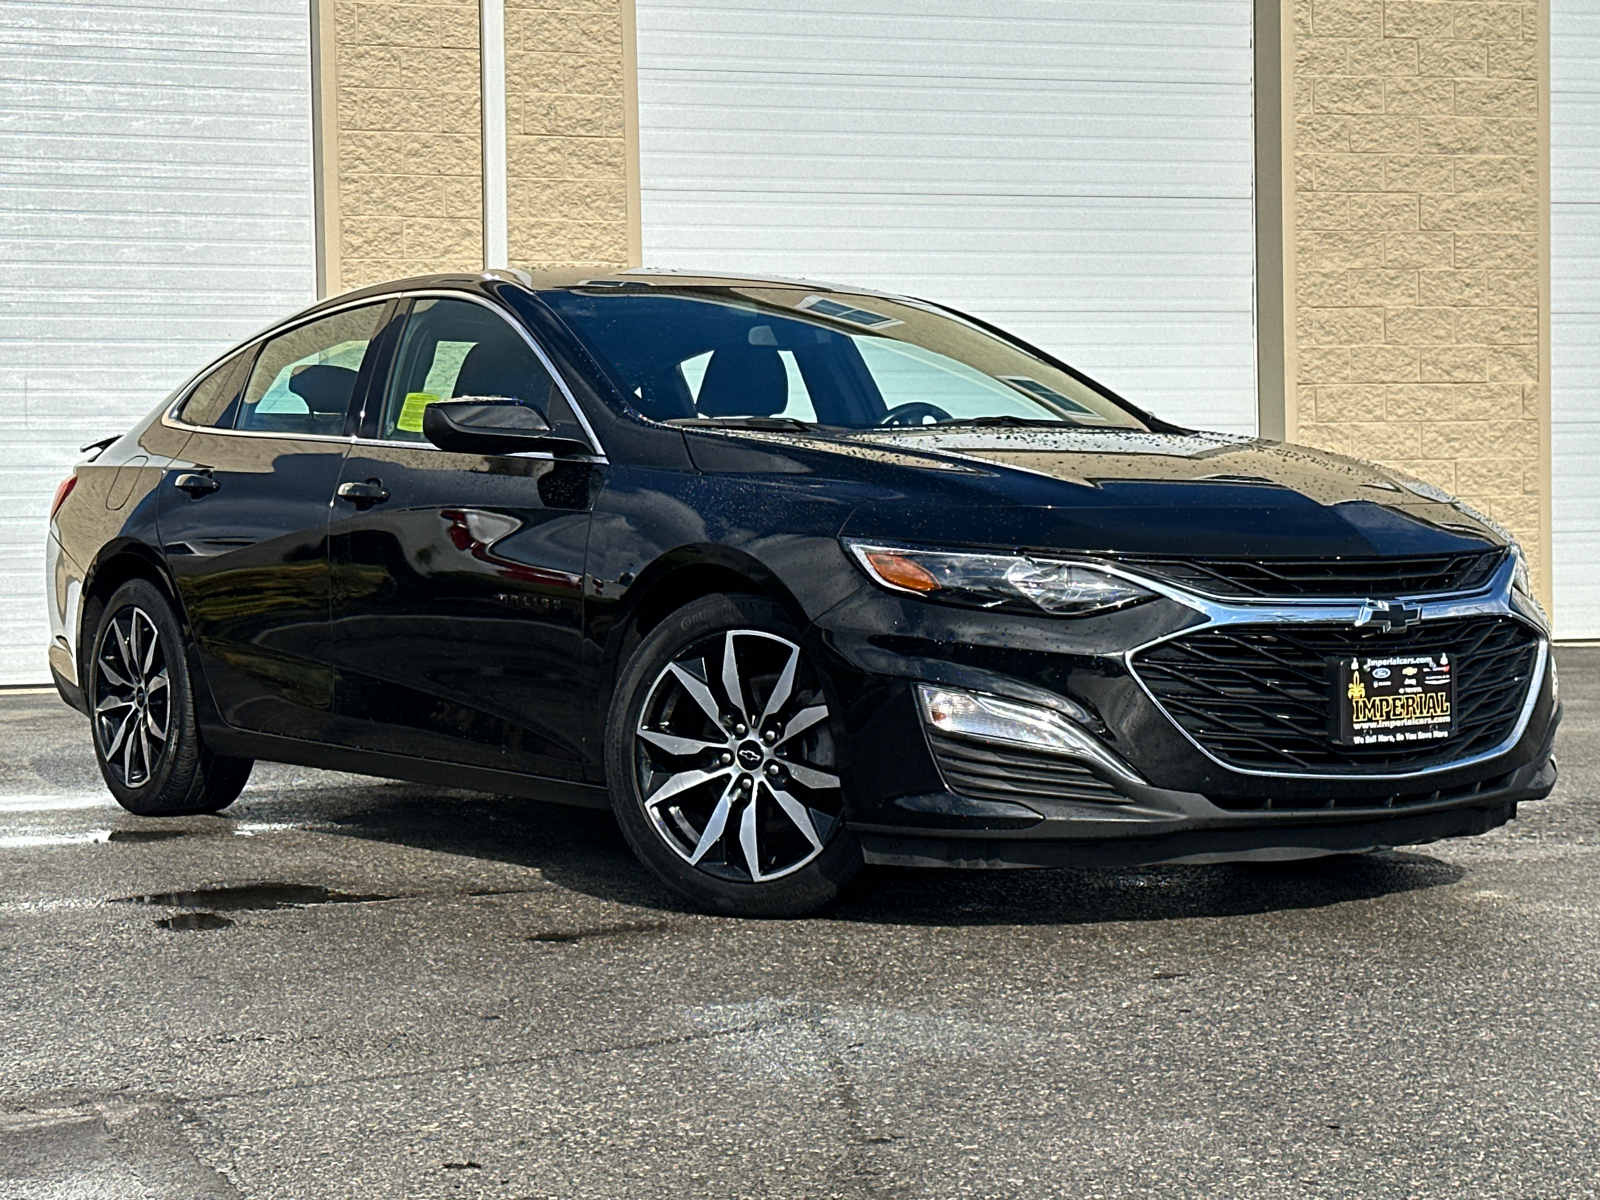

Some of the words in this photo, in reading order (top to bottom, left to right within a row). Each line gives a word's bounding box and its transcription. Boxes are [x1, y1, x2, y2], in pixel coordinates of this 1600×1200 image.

[1367, 657, 1433, 667] Imperialcars.com
[1353, 692, 1451, 722] IMPERIAL
[1353, 736, 1364, 744] We
[1365, 735, 1377, 743] Sell
[1396, 733, 1405, 741] So
[1405, 732, 1417, 740] You
[1417, 731, 1432, 740] Save
[1433, 730, 1448, 738] More
